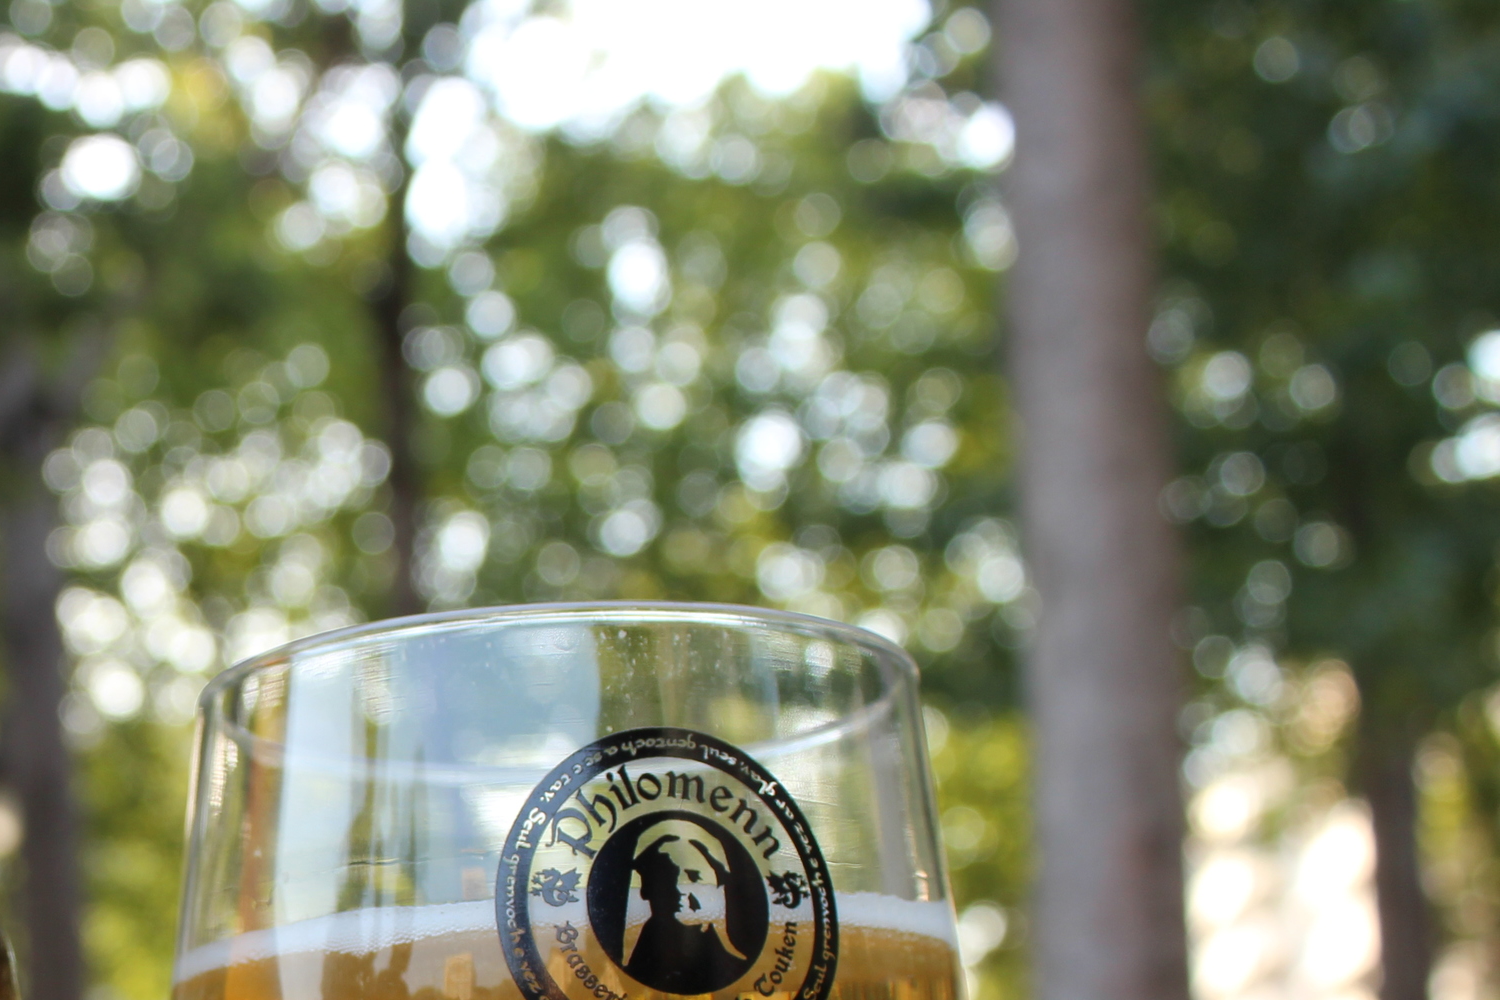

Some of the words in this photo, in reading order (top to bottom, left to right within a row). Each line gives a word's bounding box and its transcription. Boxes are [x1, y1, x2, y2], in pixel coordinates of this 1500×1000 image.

[515, 807, 546, 849] Seul
[545, 763, 780, 860] Philomenn
[754, 920, 798, 998] Touken
